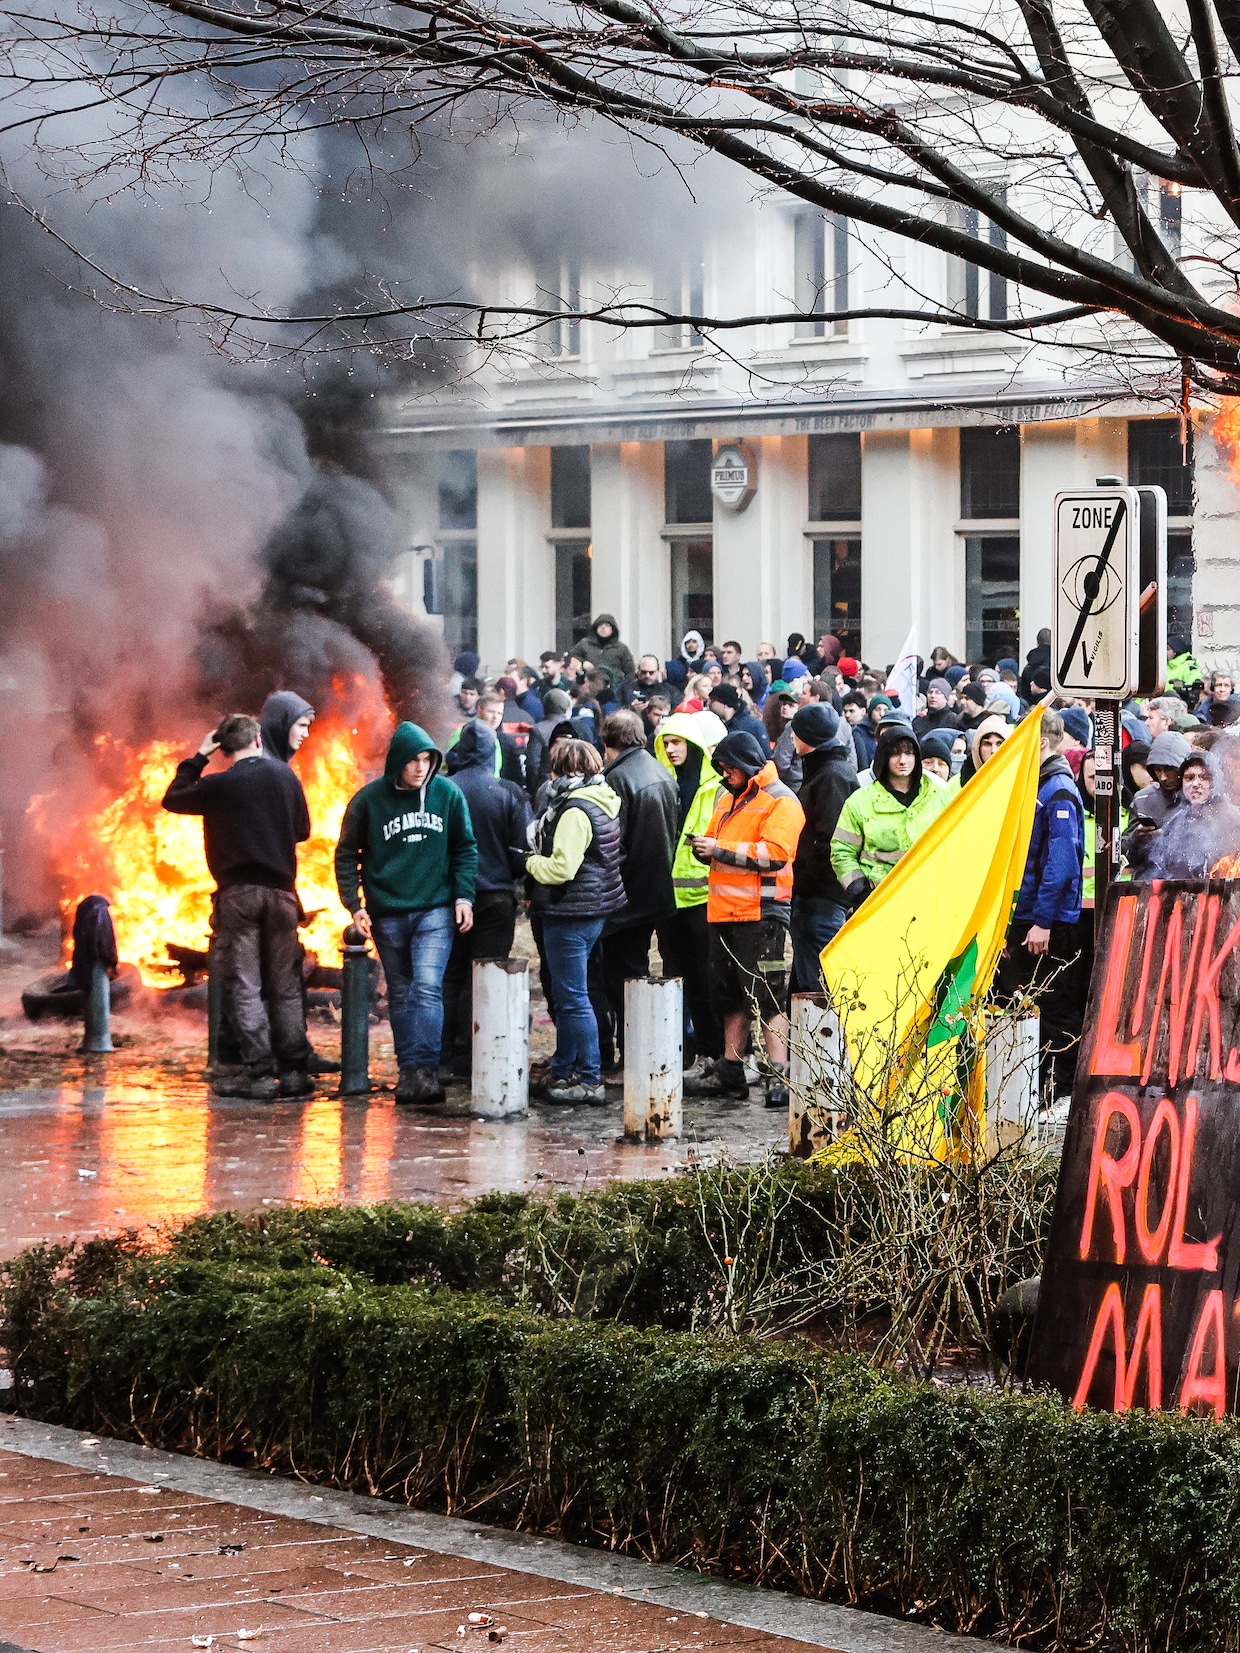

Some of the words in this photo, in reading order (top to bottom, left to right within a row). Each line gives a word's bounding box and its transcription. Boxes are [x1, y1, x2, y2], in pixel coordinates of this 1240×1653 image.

[796, 416, 810, 431] THE
[814, 415, 836, 430] BEER
[839, 413, 876, 429] FACTORY
[996, 407, 1013, 420] THE
[1017, 405, 1040, 420] BEER
[1044, 402, 1086, 418] FACTORY
[715, 470, 745, 481] PRIMUS
[1072, 507, 1112, 529] ZONE
[1090, 630, 1103, 660] VIGILIS
[383, 816, 401, 841] LOS
[402, 811, 444, 833] ANGELES
[1080, 1093, 1221, 1272] ROL
